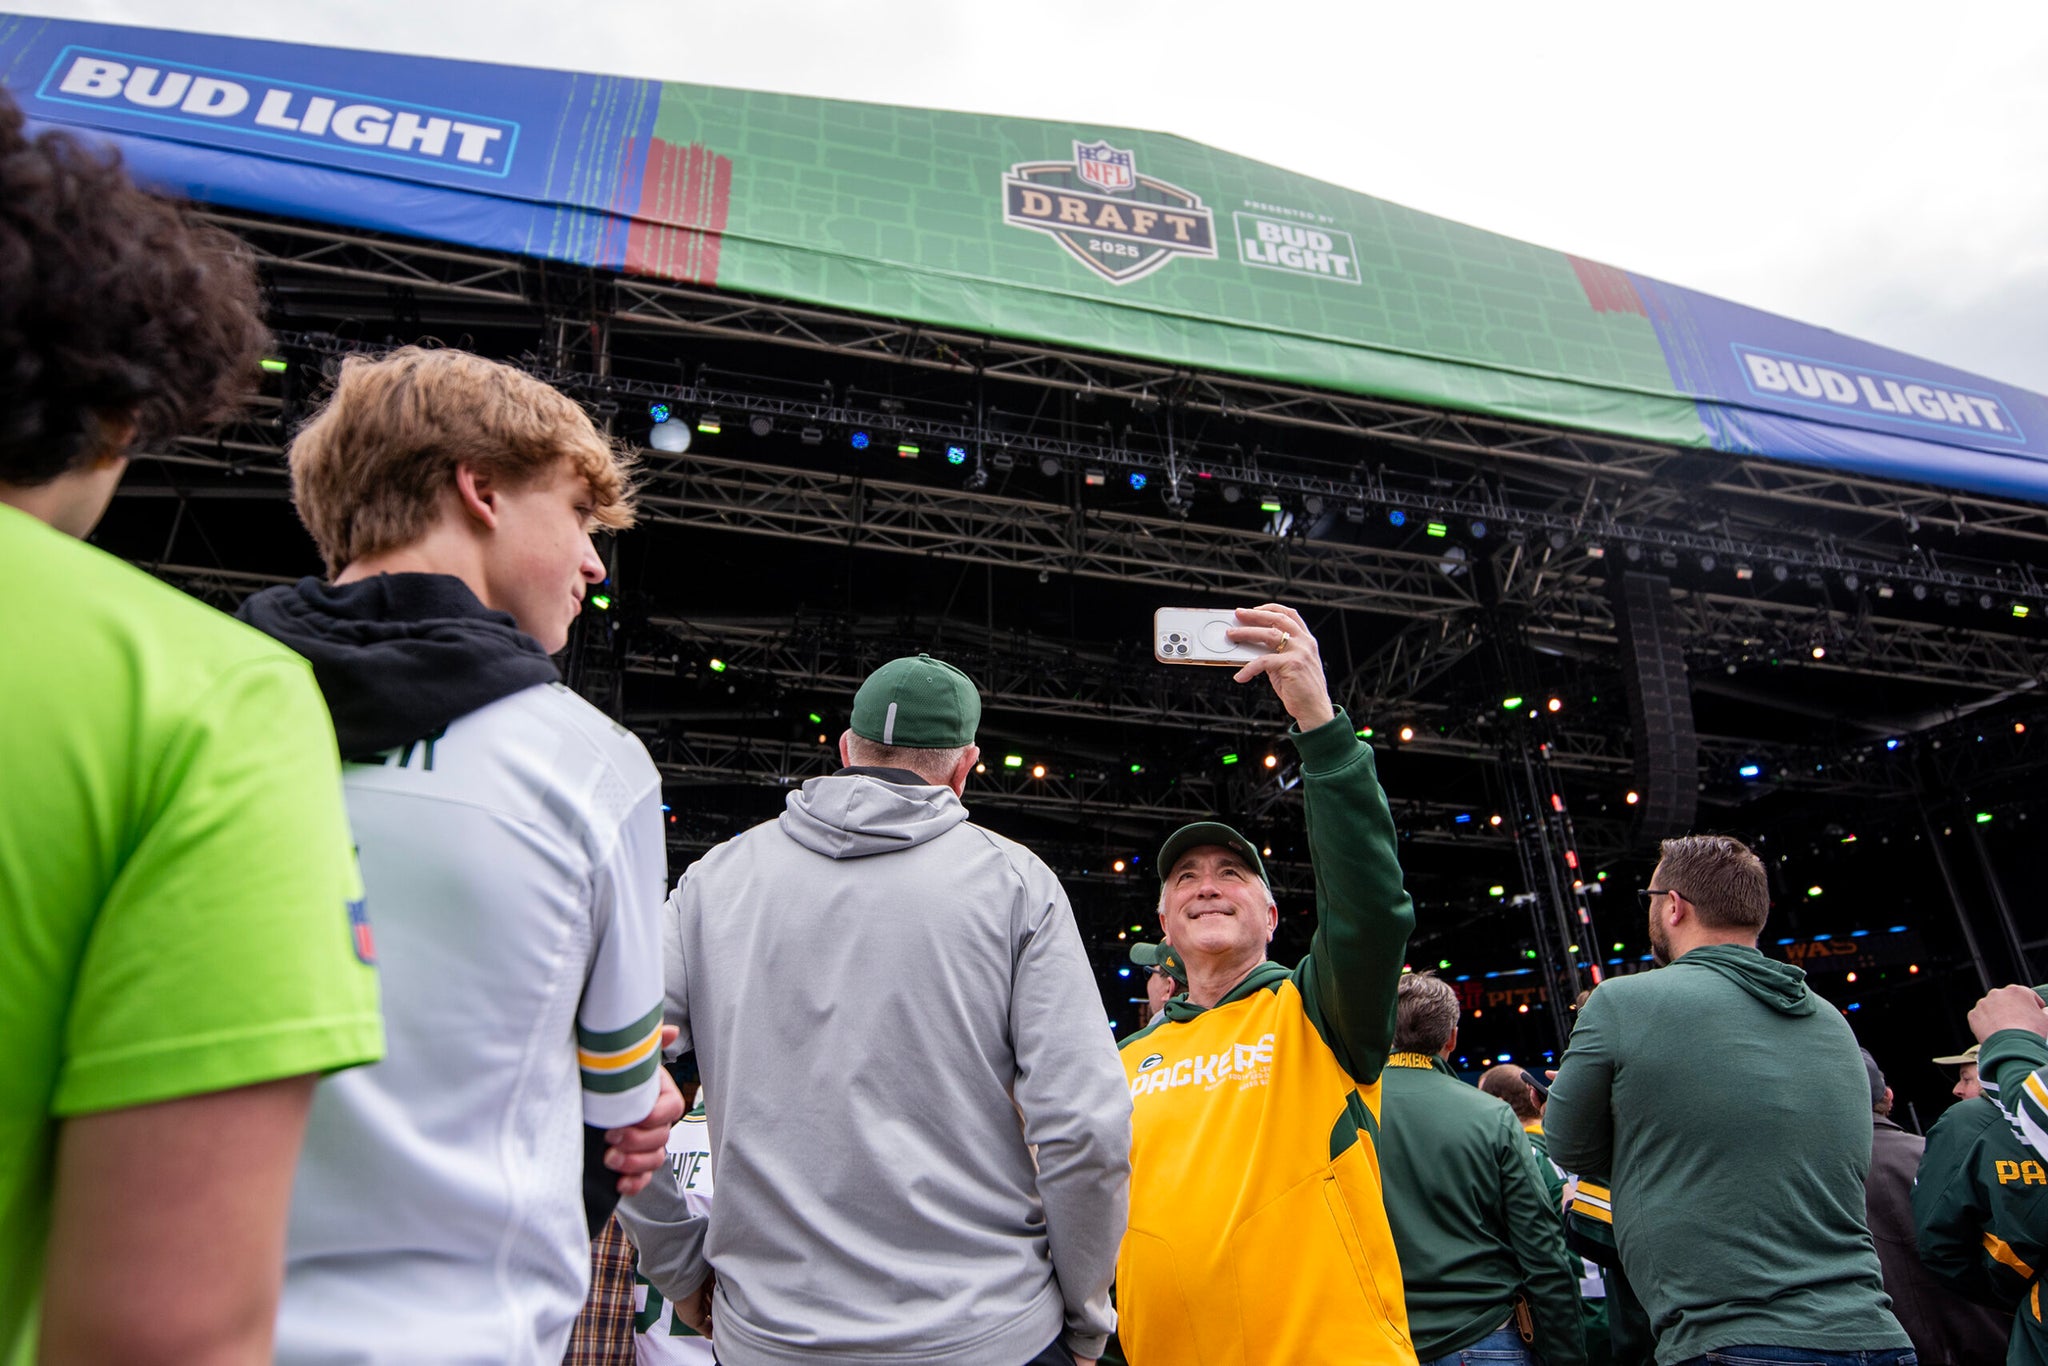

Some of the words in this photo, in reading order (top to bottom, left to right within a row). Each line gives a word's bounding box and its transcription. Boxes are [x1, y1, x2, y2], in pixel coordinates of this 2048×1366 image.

[58, 56, 250, 118] BUD
[254, 89, 502, 165] LIGHT
[1085, 160, 1129, 185] NFL
[1021, 189, 1197, 241] DRAFT
[1244, 199, 1315, 220] PRESENTED
[1089, 239, 1140, 258] 2025
[1256, 220, 1334, 253] BUD
[1245, 238, 1351, 278] LIGHT
[1744, 353, 1859, 404] BUD
[1857, 375, 2005, 431] LIGHT
[1130, 1033, 1275, 1100] PACKERS
[669, 1151, 710, 1189] HITE
